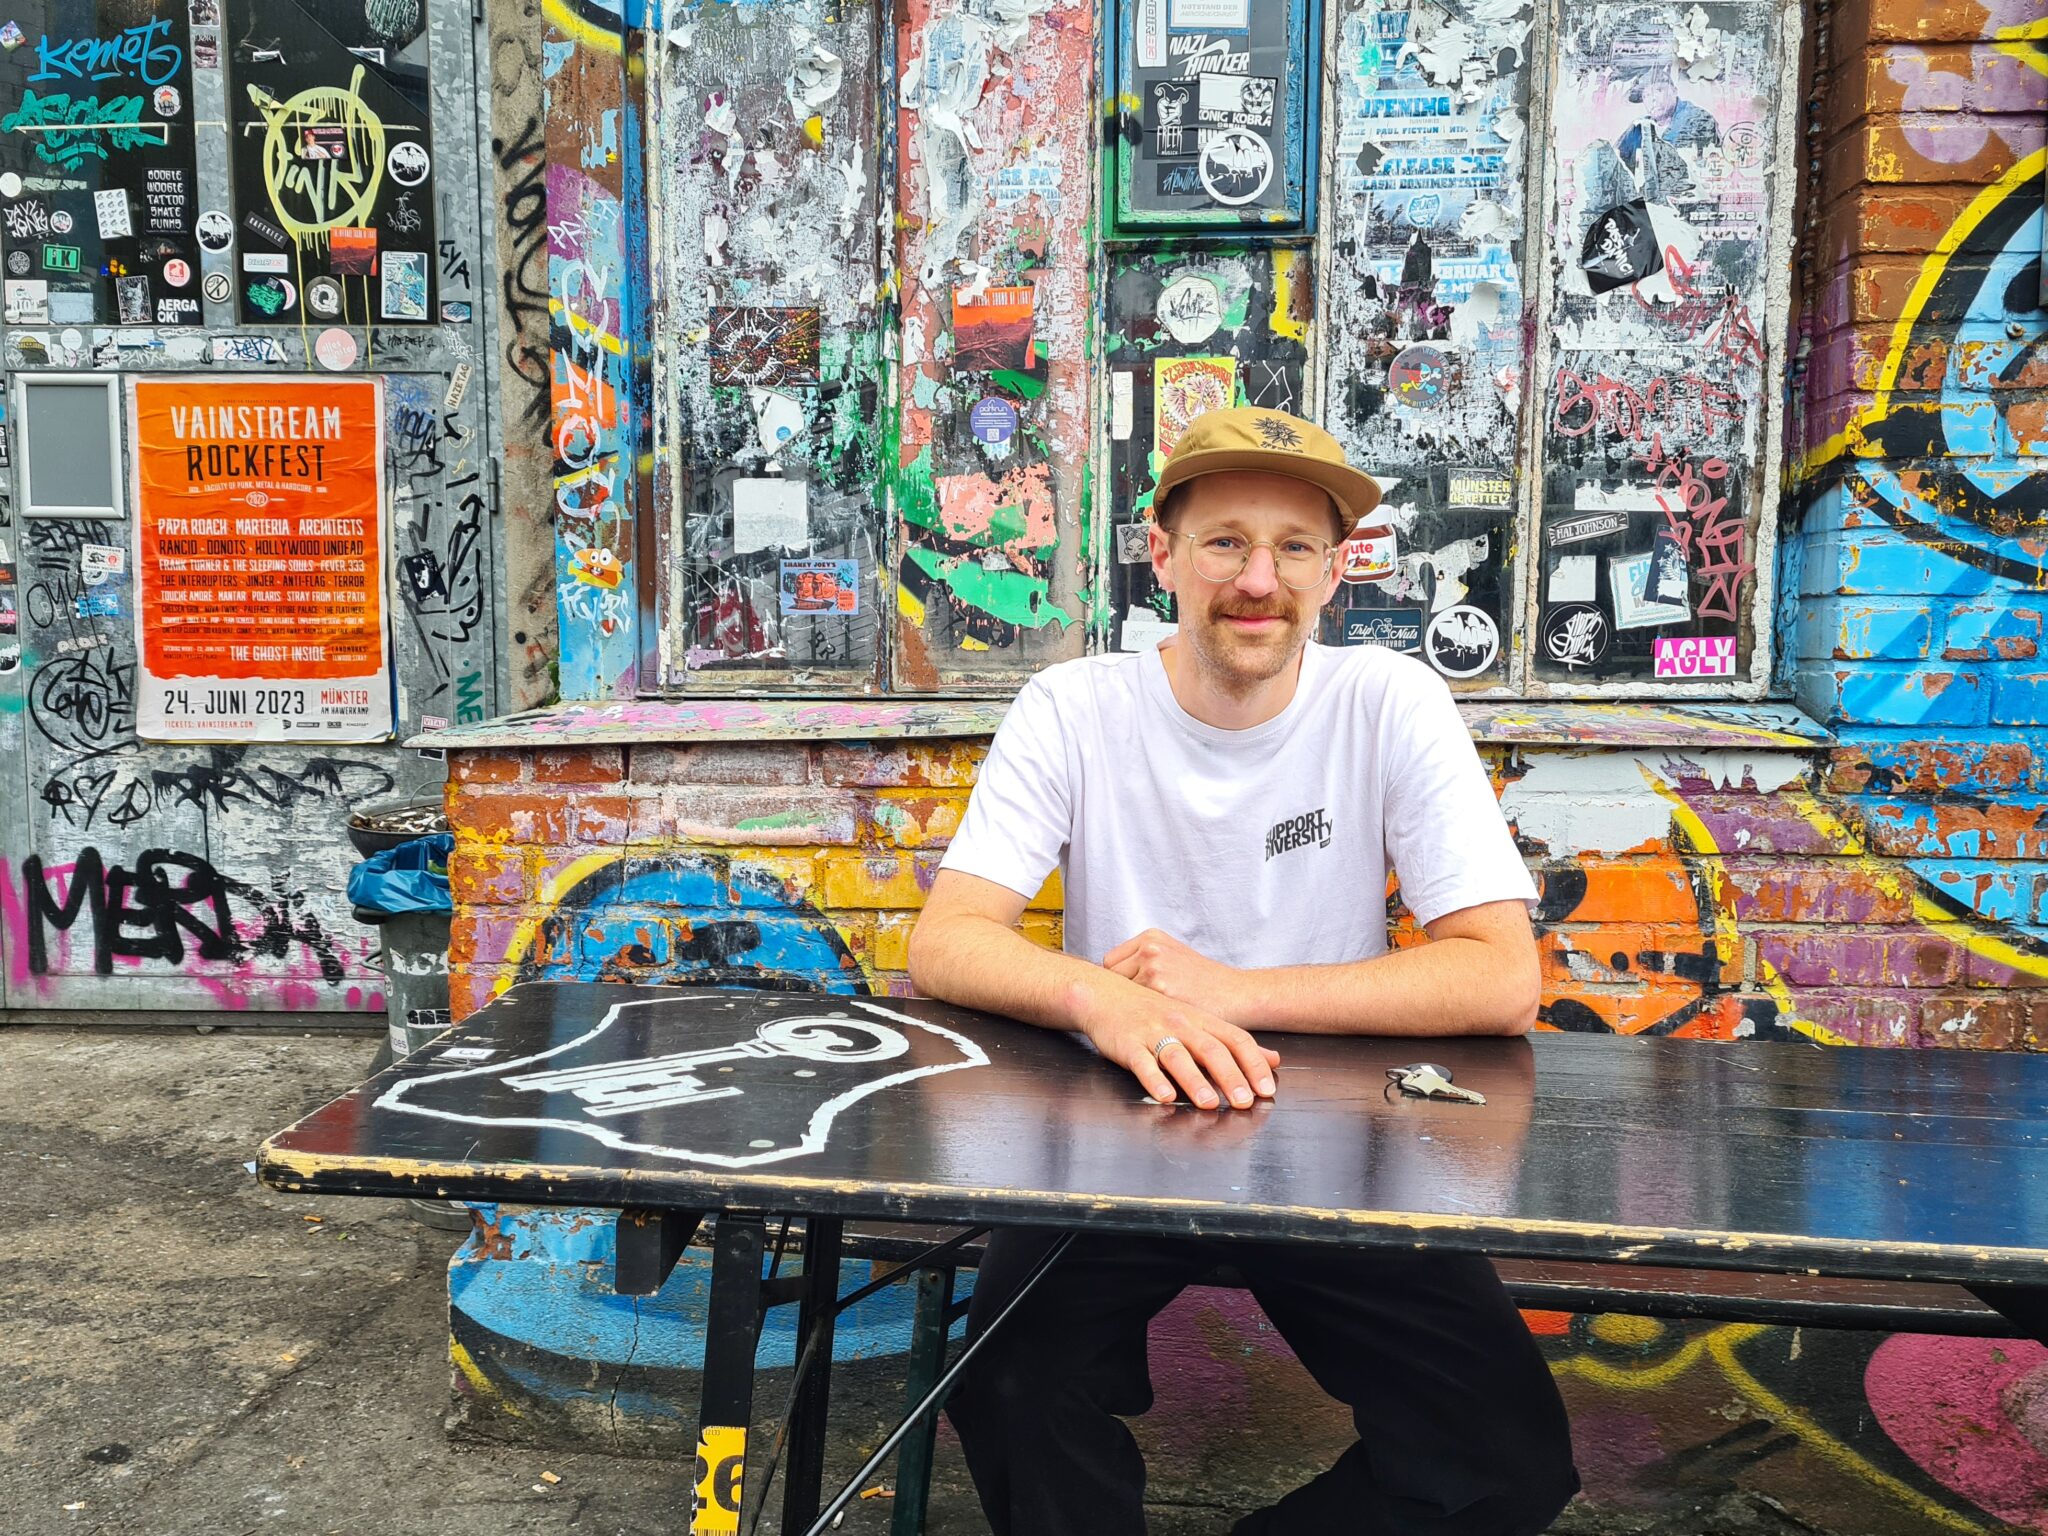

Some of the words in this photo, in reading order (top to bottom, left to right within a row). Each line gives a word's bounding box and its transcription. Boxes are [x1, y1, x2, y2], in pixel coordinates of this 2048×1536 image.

[1169, 34, 1208, 56] NAZI
[1183, 51, 1250, 76] HUNTER
[1232, 112, 1272, 127] KOBRA
[146, 194, 185, 205] TATTOO
[157, 299, 199, 312] AERGA
[170, 405, 342, 440] VAINSTREAM
[187, 444, 326, 481] ROCKFEST
[1450, 478, 1510, 492] MÜNSTER
[158, 518, 188, 535] PAPA
[191, 518, 228, 535] ROACH
[236, 518, 290, 535] MARTERIA
[299, 518, 364, 536] ARCHITECTS
[1556, 526, 1575, 540] HAL
[1574, 516, 1619, 536] JOHNSON
[160, 540, 197, 555] RANCID
[207, 540, 246, 555] DONOTS
[255, 540, 320, 555] HOLLYWOOD
[323, 540, 364, 555] UNDEAD
[159, 559, 187, 571] FRANK
[189, 559, 222, 571] TURNER
[233, 559, 248, 571] THE
[249, 559, 287, 572] SLEEPING
[288, 559, 314, 572] SOULS
[347, 560, 365, 572] 333
[160, 574, 175, 586] THE
[178, 574, 238, 587] INTERRUPTERS
[246, 575, 275, 587] JINJER
[282, 575, 326, 587] ANTI-FLAG
[333, 575, 366, 587] TERROR
[218, 591, 247, 602] MANTAR
[252, 591, 281, 602] POLARIS
[287, 591, 310, 602] STRAY
[312, 591, 331, 602] FROM
[333, 591, 346, 602] THE
[346, 591, 366, 603] PATH
[1348, 623, 1373, 639] Trip
[1390, 625, 1418, 640] Nuts
[229, 645, 249, 661] THE
[253, 645, 288, 661] GHOST
[291, 645, 326, 662] INSIDE
[1656, 638, 1734, 676] AGLY
[164, 690, 196, 715] 24.
[205, 690, 247, 715] JUNI
[255, 690, 305, 714] 2023
[320, 687, 369, 705] MÜNSTER
[320, 707, 330, 715] AM
[331, 706, 369, 715] HAWERKAMP
[164, 720, 194, 729] TICKETS:
[424, 718, 447, 728] VITAL
